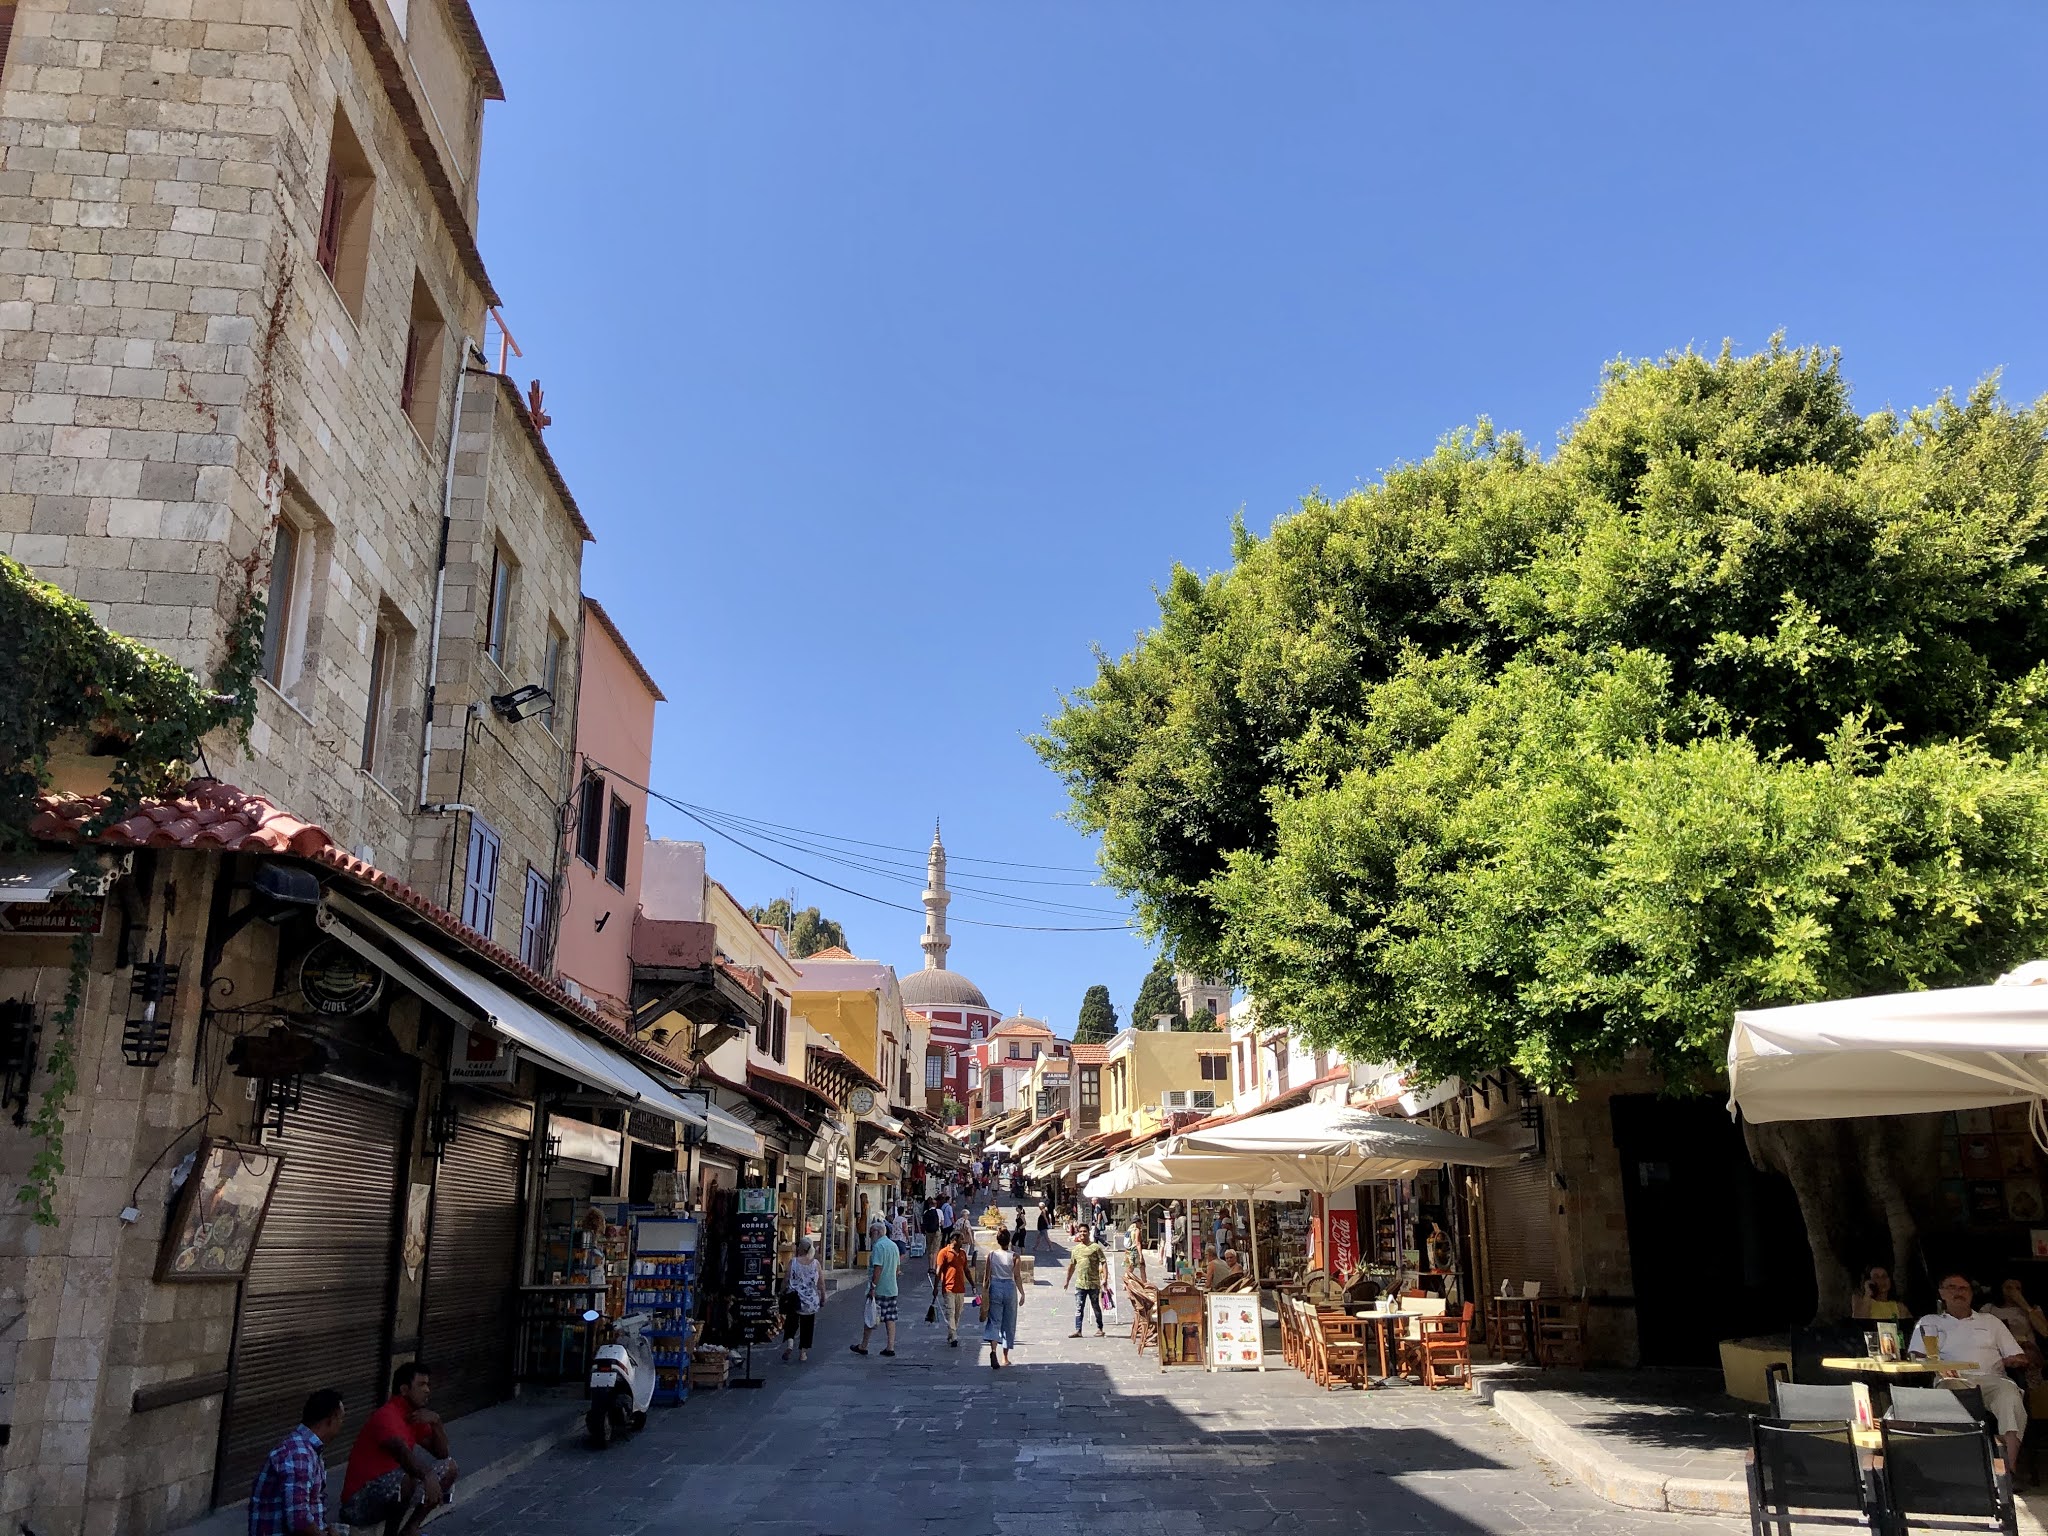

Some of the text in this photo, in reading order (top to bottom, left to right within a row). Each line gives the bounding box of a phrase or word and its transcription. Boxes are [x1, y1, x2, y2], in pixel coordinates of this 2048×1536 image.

[19, 916, 66, 927] HAMMAM
[321, 1000, 348, 1013] CIDER
[452, 1067, 508, 1078] HAUSBRANDT
